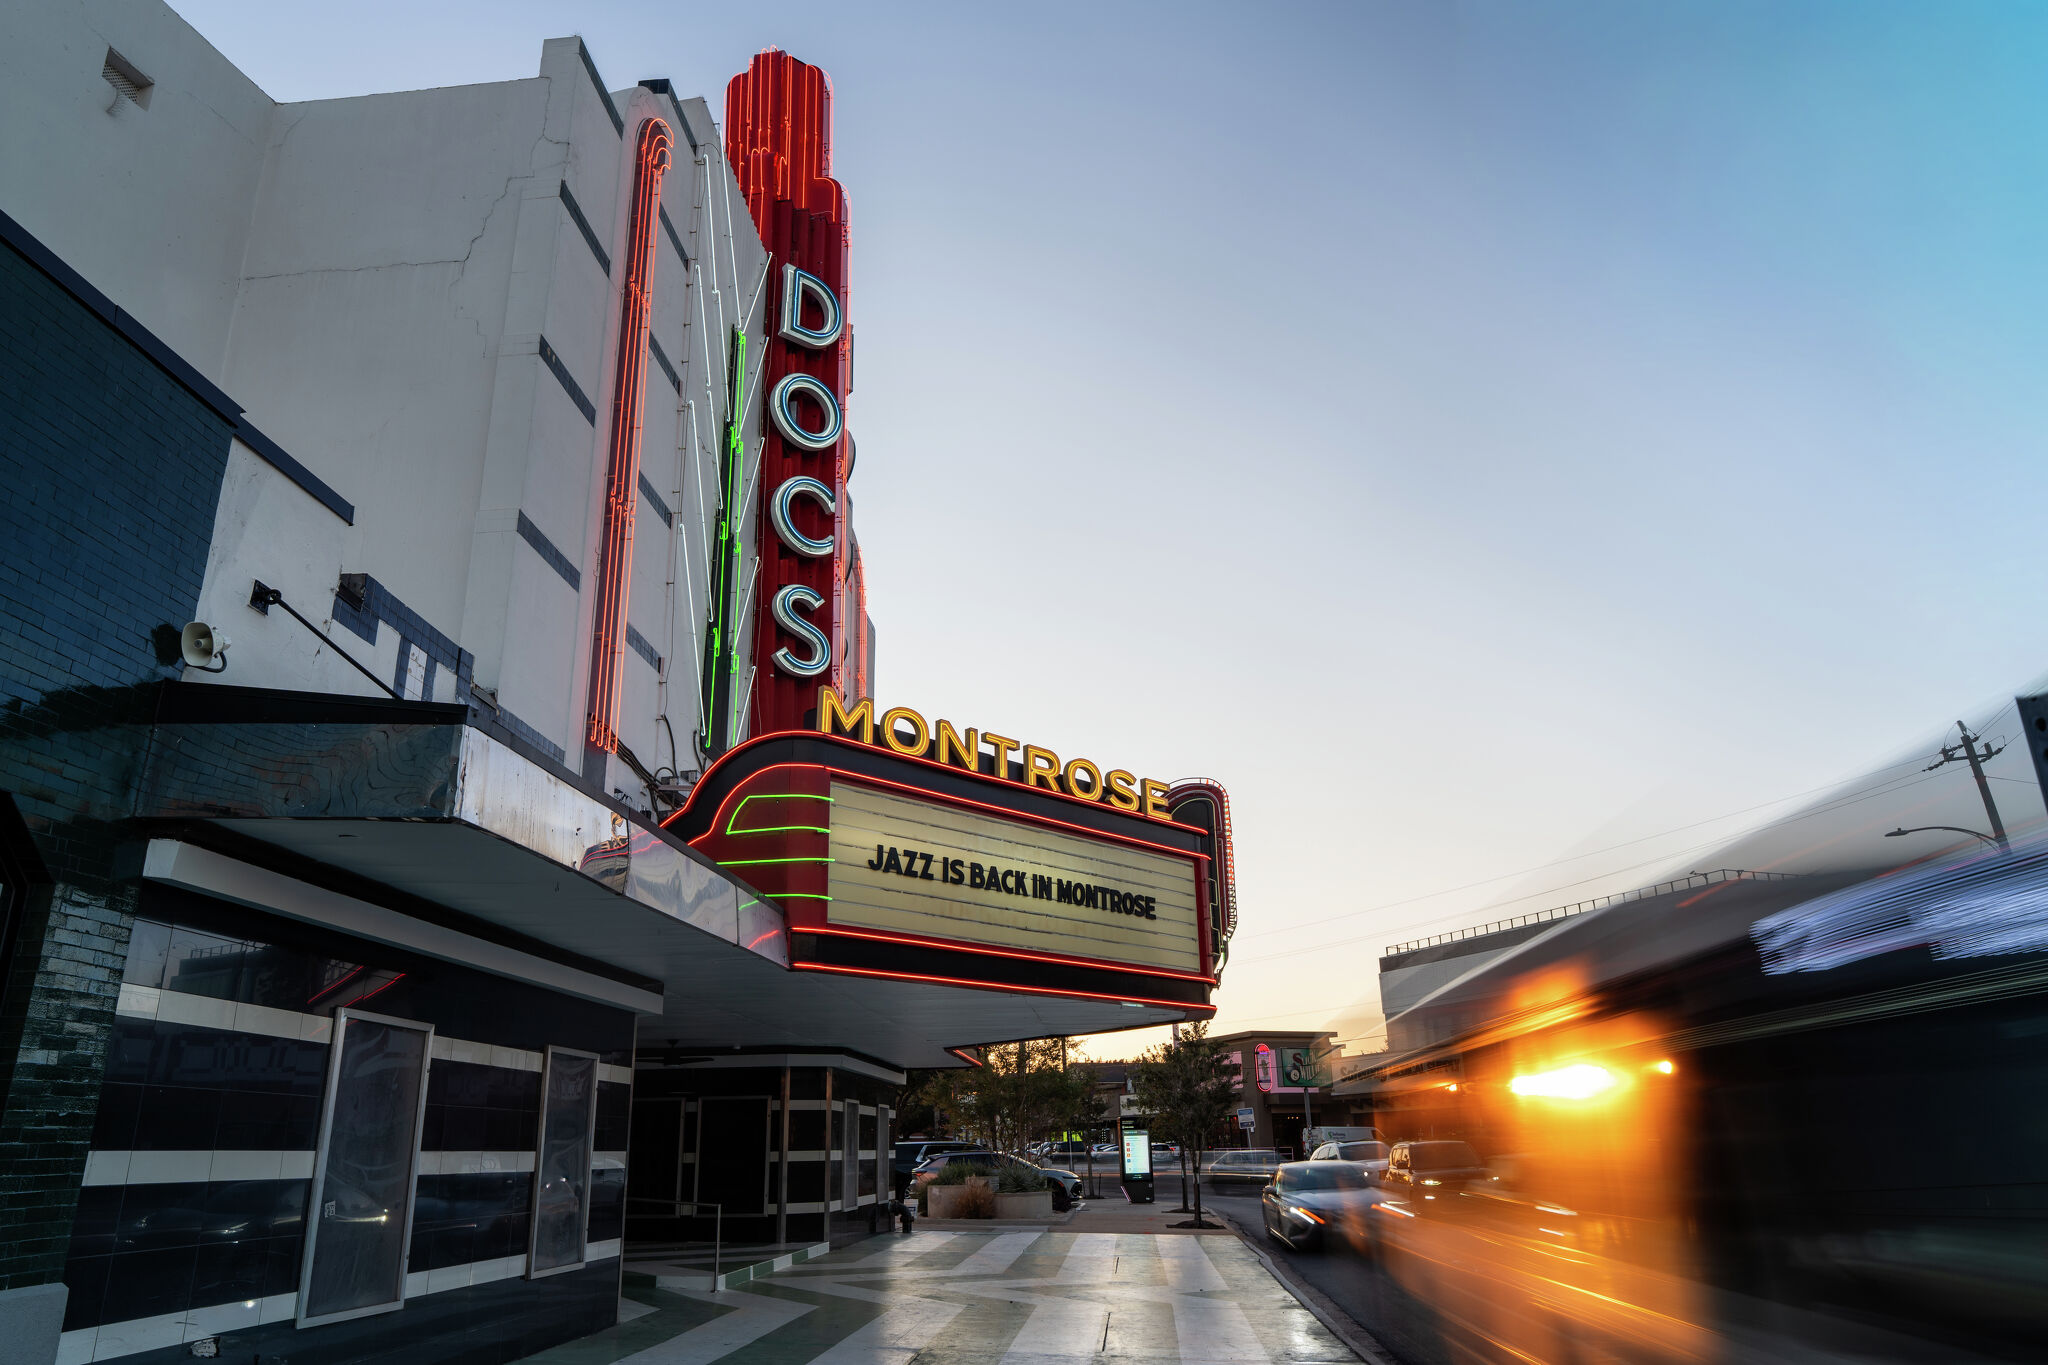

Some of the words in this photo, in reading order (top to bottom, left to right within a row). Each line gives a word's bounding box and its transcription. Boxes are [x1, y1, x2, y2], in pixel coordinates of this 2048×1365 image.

[770, 262, 843, 677] DOCS
[816, 685, 1173, 820] MONTROSE
[868, 844, 934, 880] JAZZ
[942, 857, 965, 885] IS
[970, 862, 1028, 897] BACK
[1032, 874, 1052, 900] IN
[1056, 879, 1156, 920] MONTROSE
